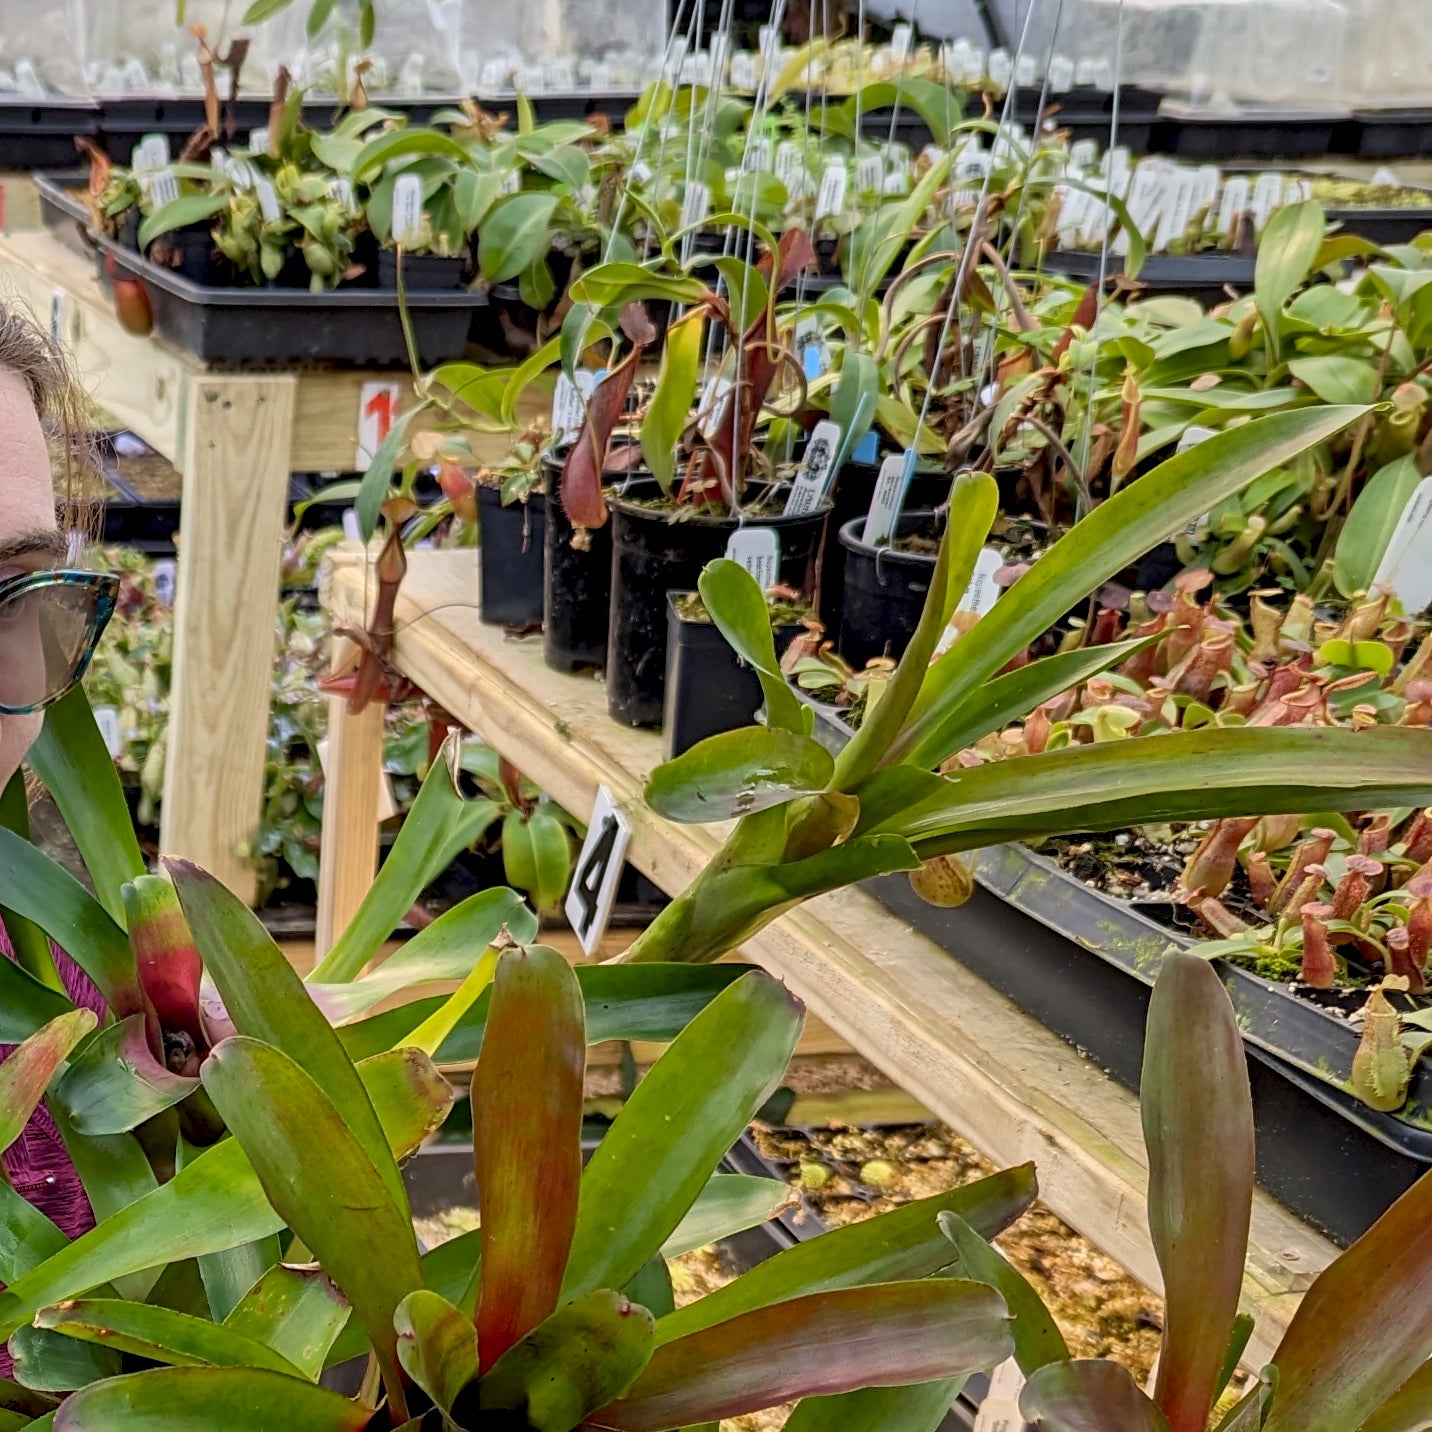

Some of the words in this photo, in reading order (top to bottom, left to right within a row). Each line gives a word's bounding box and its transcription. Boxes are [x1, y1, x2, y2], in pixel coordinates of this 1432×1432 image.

[365, 389, 392, 447] 1
[969, 573, 987, 612] Nepenthe
[574, 814, 619, 942] 4
